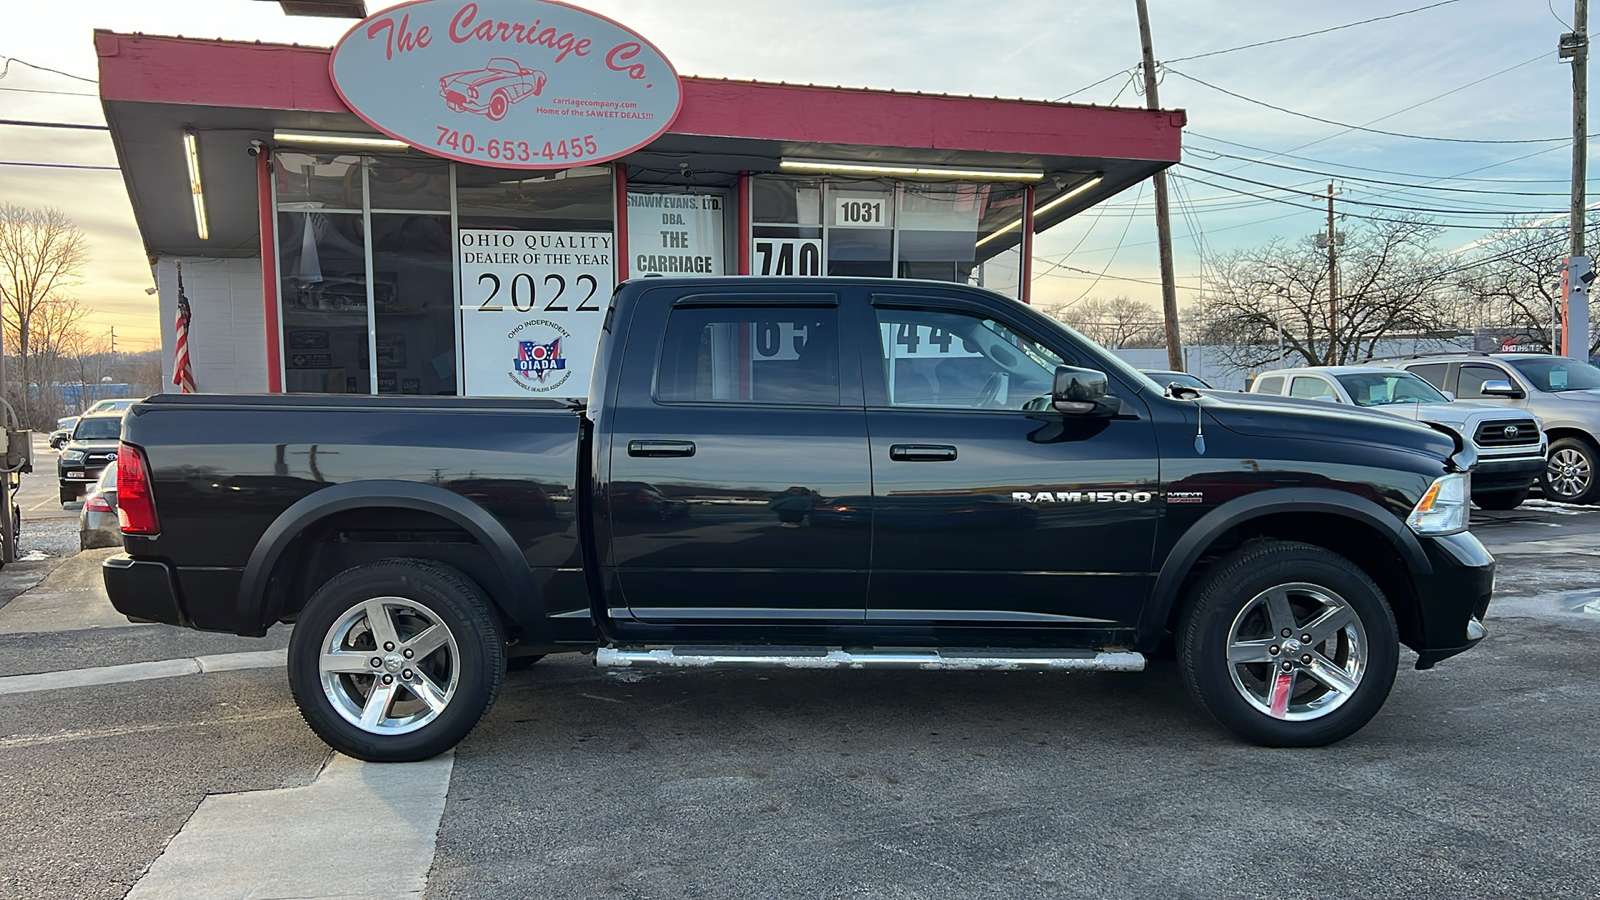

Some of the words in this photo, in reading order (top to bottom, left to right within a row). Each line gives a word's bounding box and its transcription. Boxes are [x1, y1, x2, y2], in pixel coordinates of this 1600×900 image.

[367, 13, 433, 60] The
[449, 2, 592, 63] Carriage
[605, 42, 653, 89] Co.
[553, 98, 637, 109] carriagecompany.com
[536, 107, 560, 115] Home
[561, 108, 570, 116] of
[586, 110, 619, 118] SAWEET
[620, 111, 654, 120] DEALS!!!
[436, 125, 598, 162] 740-653-4455
[702, 197, 722, 210] LTD.
[662, 213, 685, 225] DBA.
[841, 202, 881, 223] 1031
[461, 233, 515, 248] OHIO
[524, 235, 611, 250] QUALITY
[660, 231, 688, 248] THE
[464, 252, 519, 264] DEALER
[522, 253, 540, 264] OF
[544, 253, 571, 265] THE
[575, 254, 609, 265] YEAR
[637, 254, 712, 273] CARRIAGE
[477, 272, 600, 312] 2022
[508, 324, 523, 339] OHIO
[523, 319, 571, 339] INDEPENDENT
[520, 359, 558, 370] OIADA
[507, 371, 531, 391] AUTOMOBILE
[550, 369, 572, 390] ASSOCIATION
[1012, 491, 1082, 504] RAM
[1087, 491, 1152, 504] 1500
